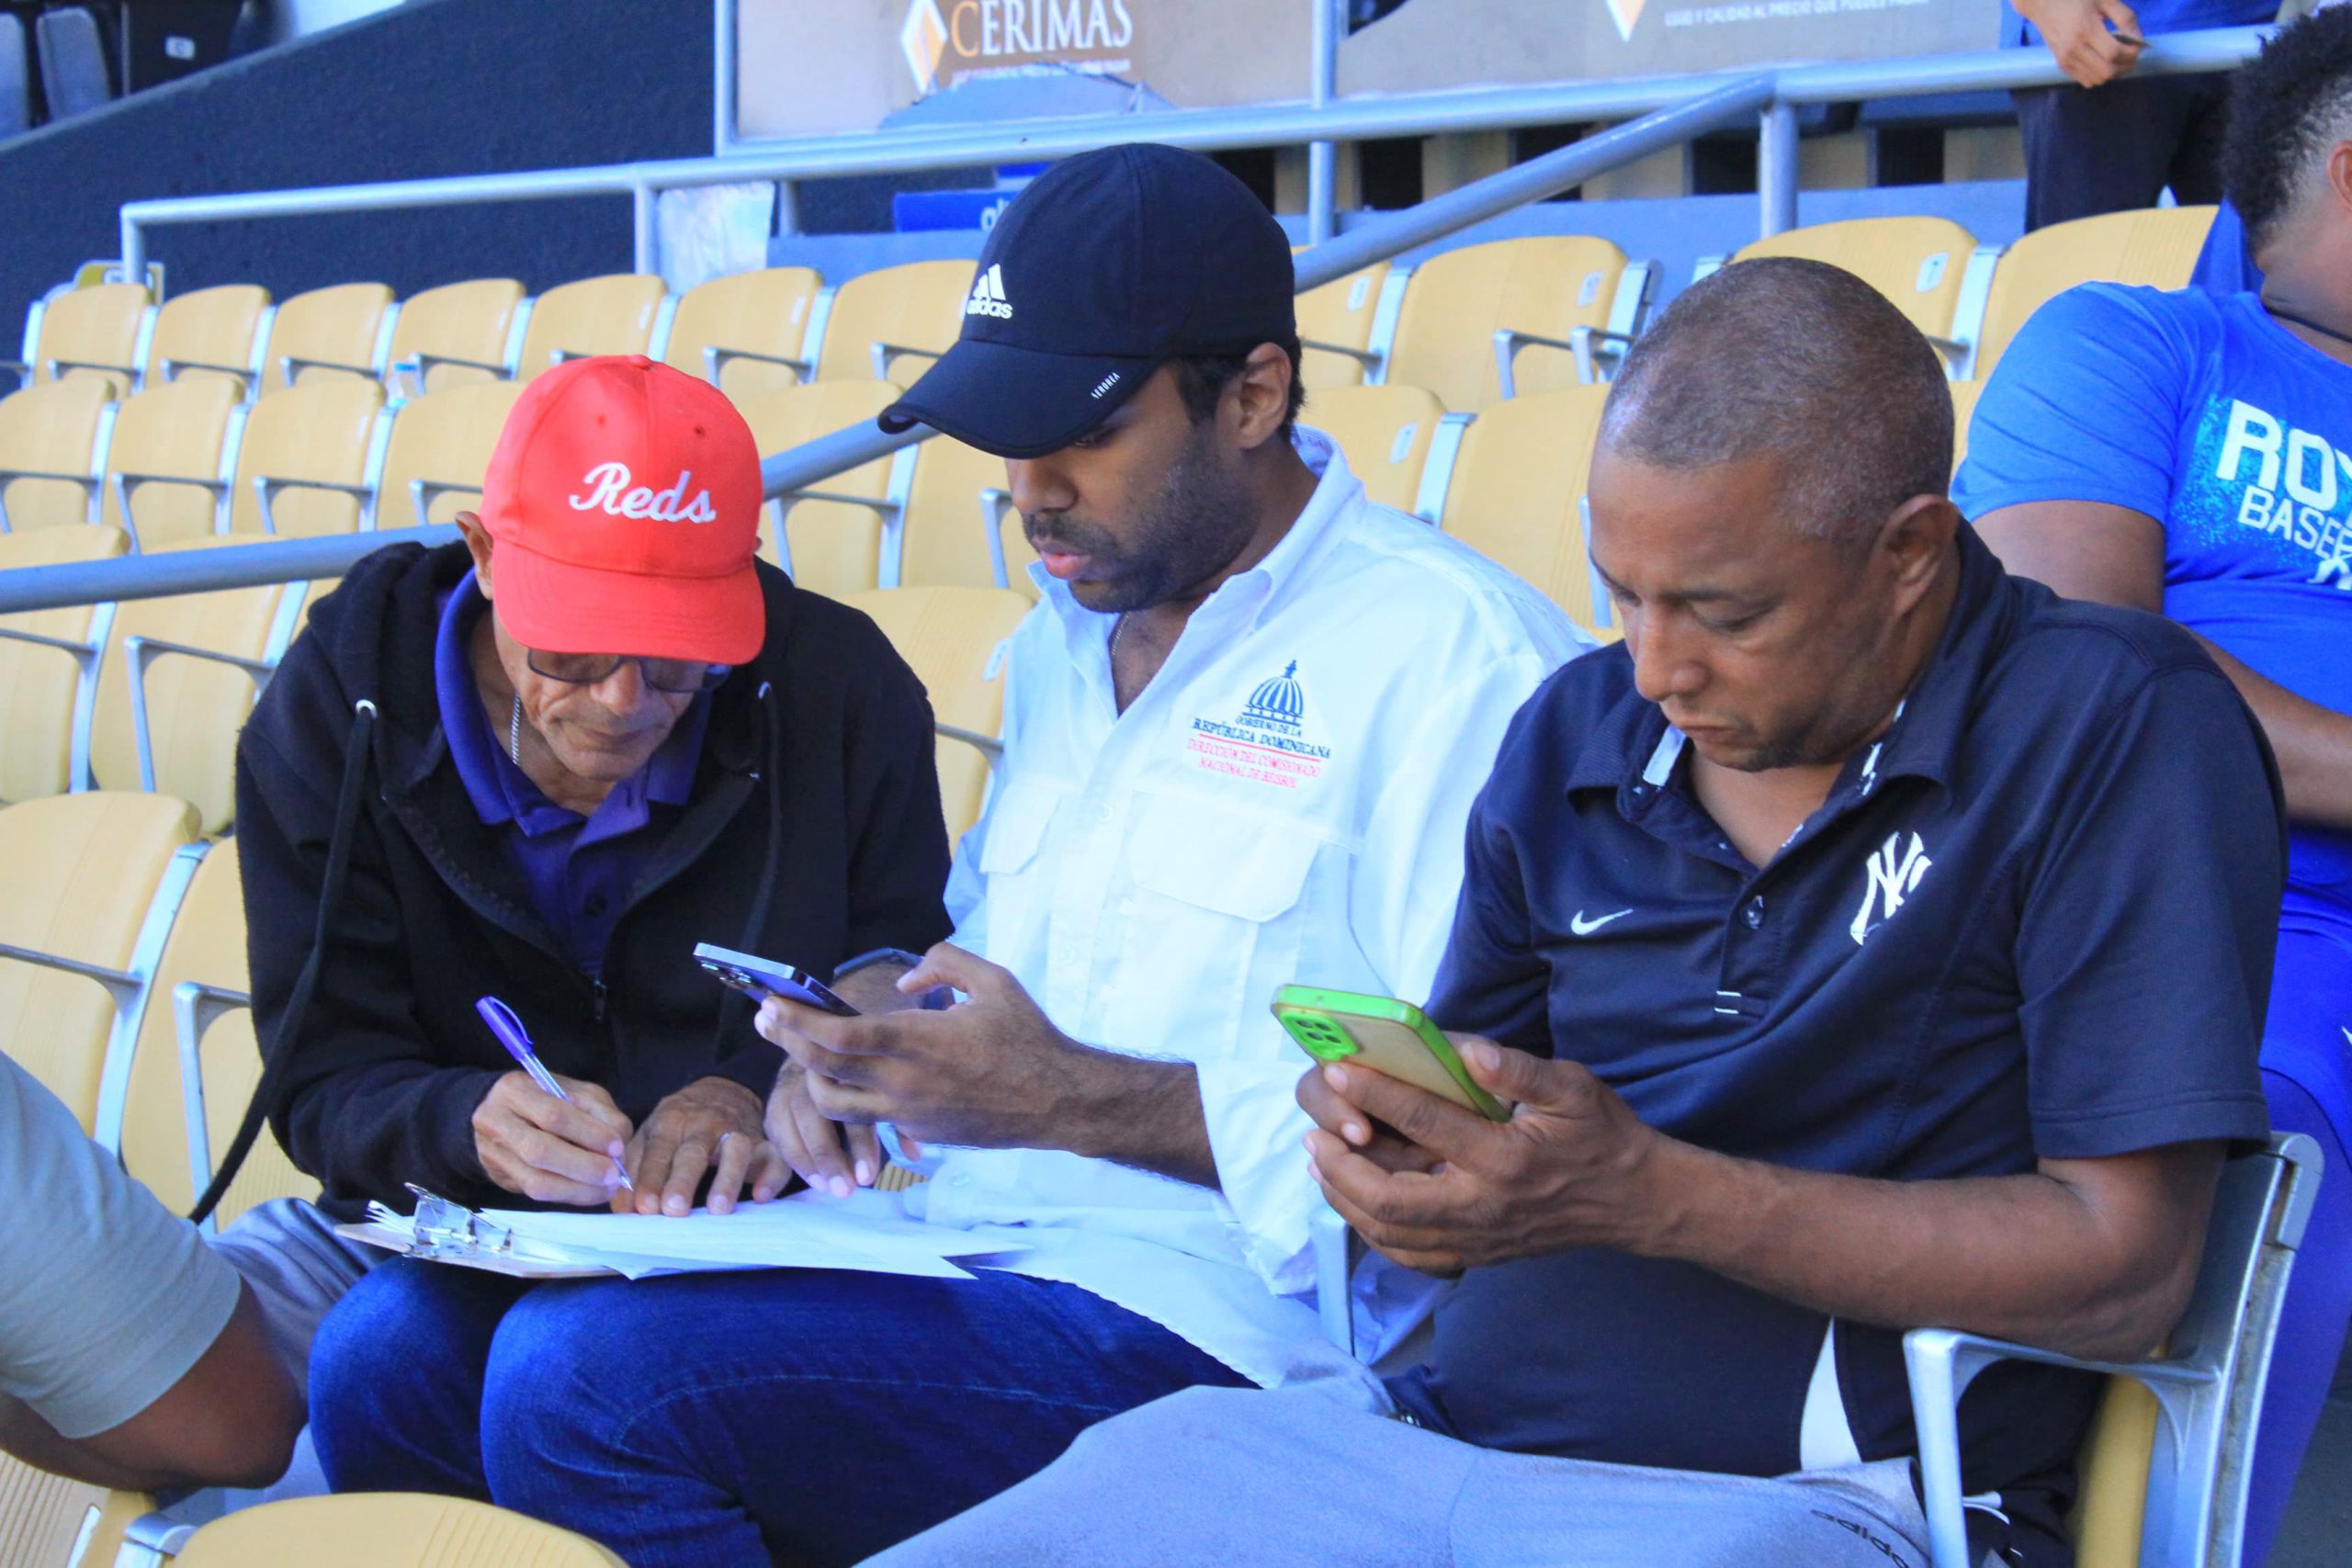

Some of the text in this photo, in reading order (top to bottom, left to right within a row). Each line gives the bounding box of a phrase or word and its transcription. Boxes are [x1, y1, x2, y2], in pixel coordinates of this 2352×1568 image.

[951, 0, 1133, 57] CERIMAS
[568, 462, 717, 524] Reds
[1259, 734, 1331, 760] DOMINICANA
[1850, 830, 1933, 946] NY
